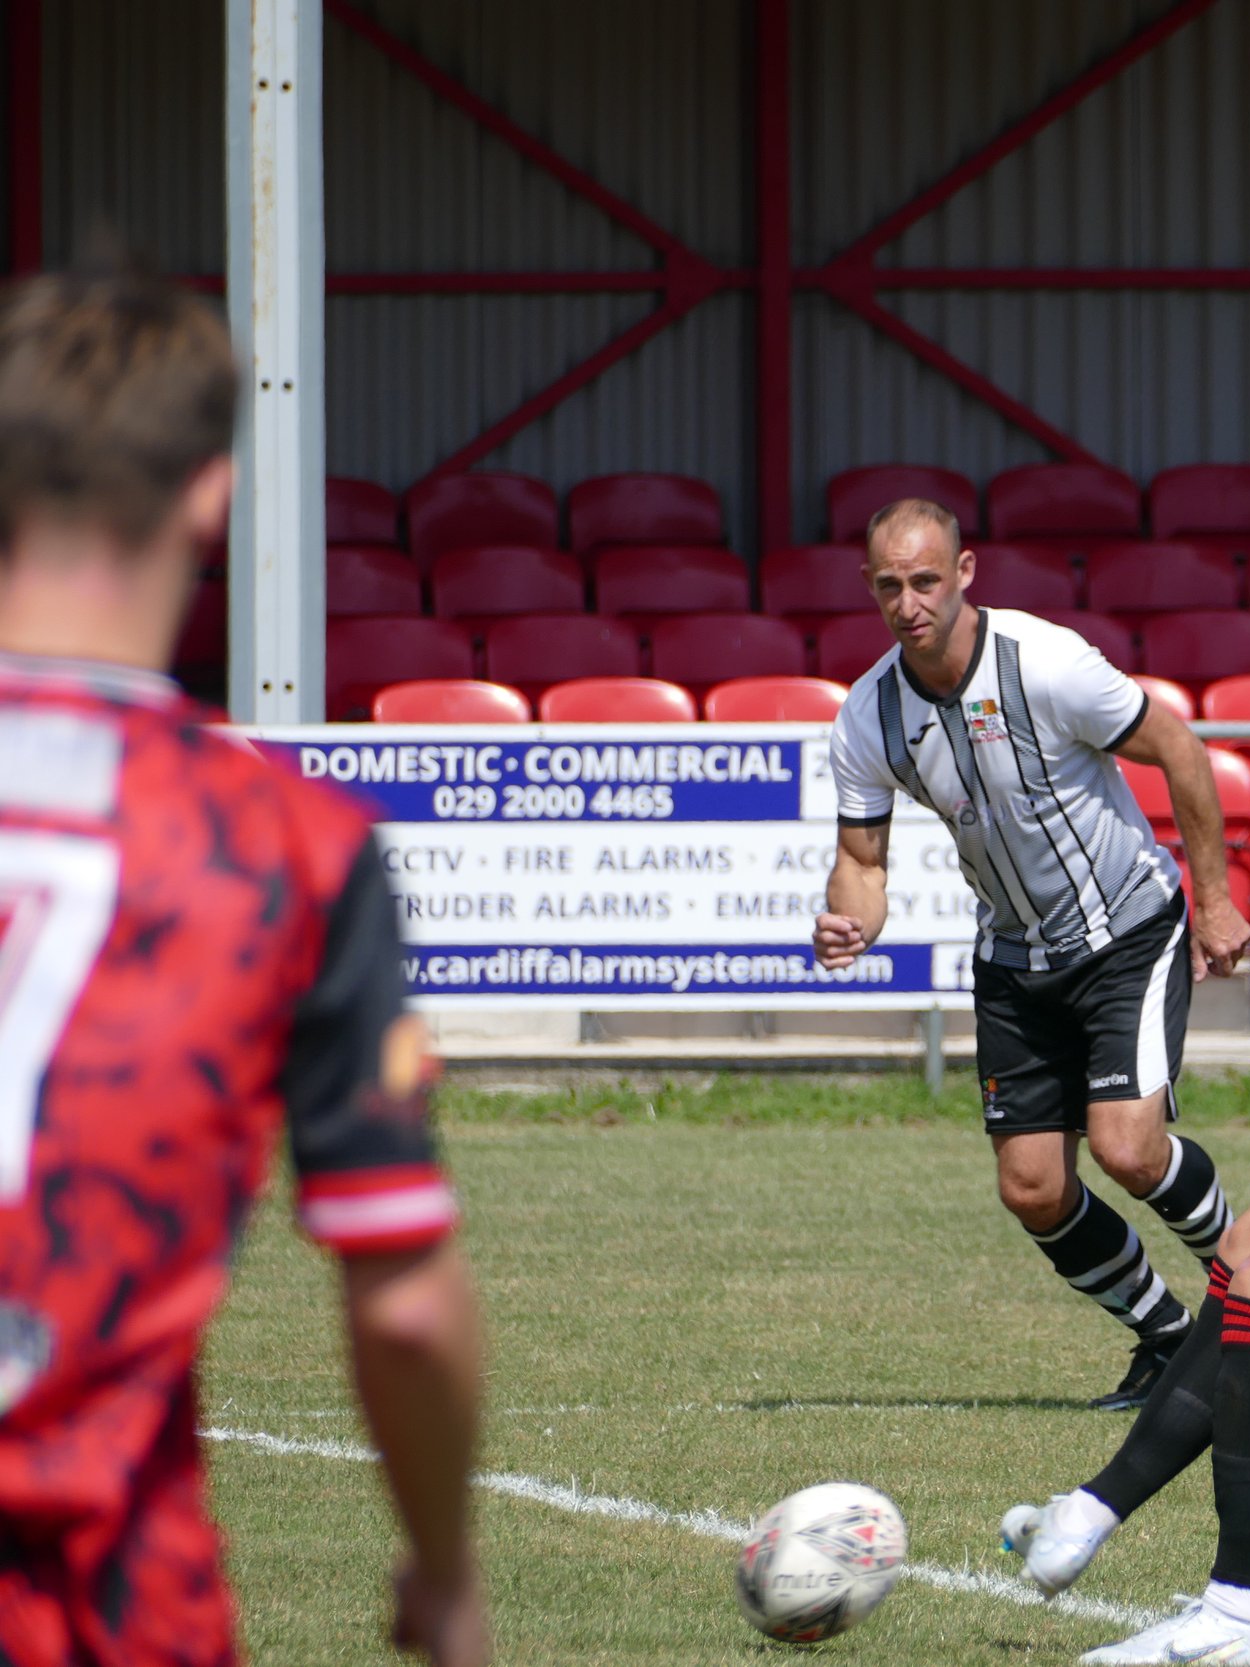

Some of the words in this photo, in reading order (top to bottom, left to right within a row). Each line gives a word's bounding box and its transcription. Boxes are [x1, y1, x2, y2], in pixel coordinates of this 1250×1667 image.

[300, 745, 503, 783] DOMESTIC
[523, 745, 793, 783] COMMERCIAL
[432, 784, 498, 818] 029
[501, 784, 586, 818] 2000
[589, 784, 675, 818] 4465
[384, 846, 463, 874] CCTV
[504, 846, 574, 874] FIRE
[597, 846, 733, 874] ALARMS
[535, 892, 673, 919] ALARMS
[773, 1568, 844, 1590] mitre
